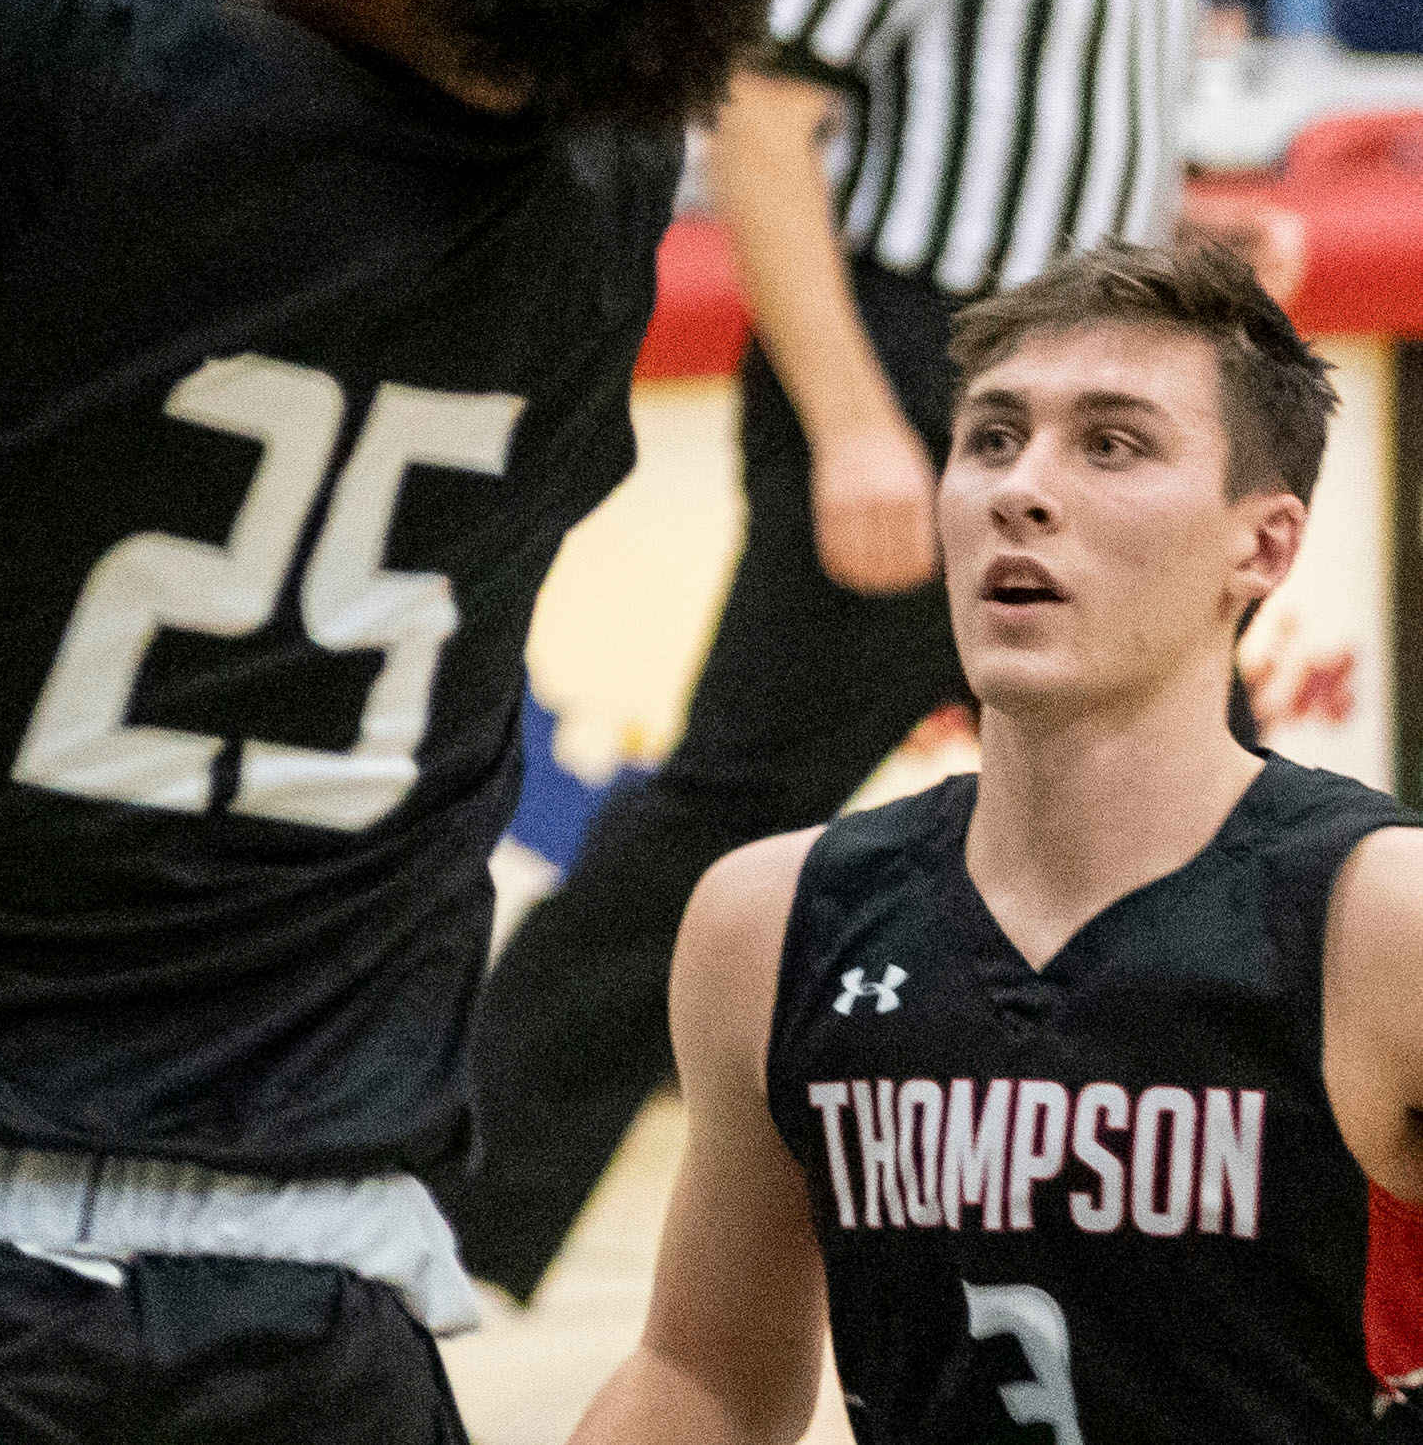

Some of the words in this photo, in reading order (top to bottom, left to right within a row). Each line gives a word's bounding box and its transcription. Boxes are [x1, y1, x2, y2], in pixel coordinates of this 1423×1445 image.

[11, 352, 525, 831] 25
[809, 1077, 1267, 1240] THOMPSON
[960, 1278, 1085, 1445] 3
